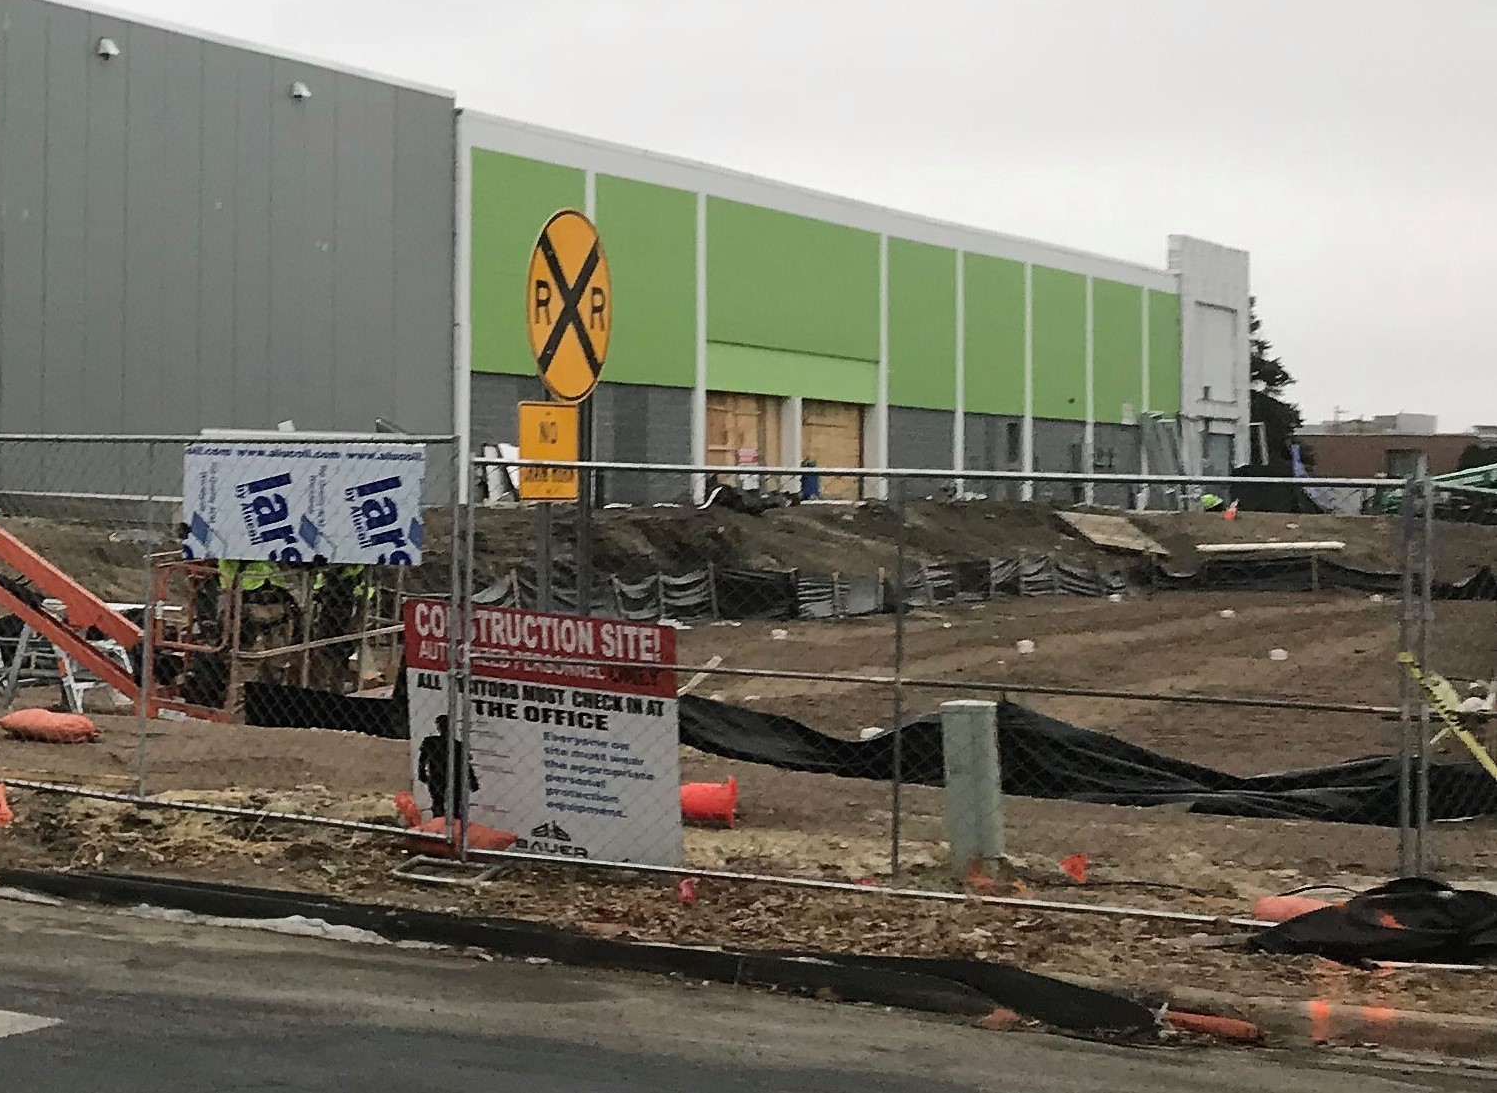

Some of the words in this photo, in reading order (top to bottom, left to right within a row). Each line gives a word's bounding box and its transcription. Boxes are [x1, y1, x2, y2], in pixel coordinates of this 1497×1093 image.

[535, 280, 552, 325] R
[589, 286, 606, 331] R
[414, 603, 595, 655] COTRUCTION
[600, 623, 661, 662] SITE!
[417, 672, 443, 691] ALL
[572, 690, 623, 713] CHECK
[470, 699, 519, 720] THE
[523, 705, 609, 731] OFFICE
